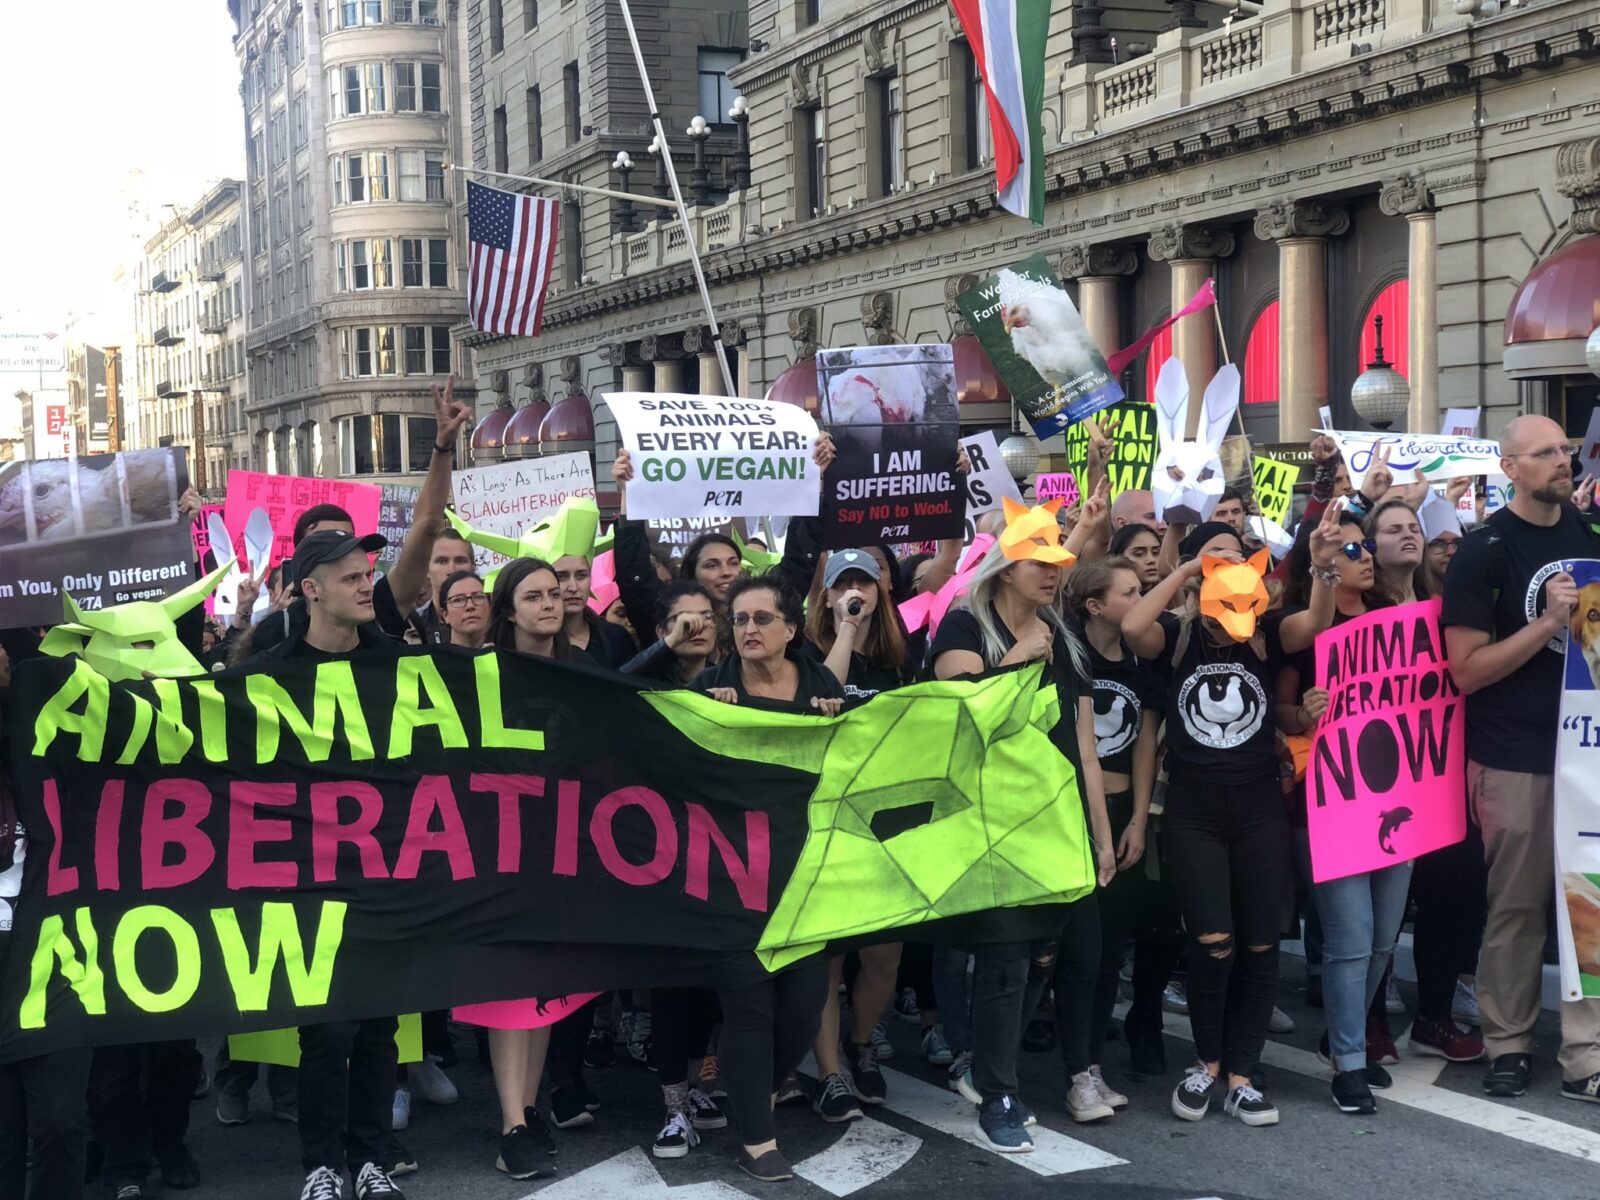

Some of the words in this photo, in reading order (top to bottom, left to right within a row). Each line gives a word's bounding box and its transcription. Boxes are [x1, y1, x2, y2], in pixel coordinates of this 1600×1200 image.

[973, 300, 1006, 323] Farm
[1045, 370, 1095, 400] Compassionate
[639, 400, 707, 411] SAVE
[715, 402, 775, 411] 100+
[1031, 400, 1055, 418] World
[659, 413, 776, 427] ANIMALS
[637, 432, 721, 451] EVERY
[730, 431, 807, 450] YEAR:
[873, 453, 880, 474] I
[887, 450, 921, 473] AM
[1342, 437, 1502, 473] Liberation
[460, 477, 477, 496] As
[515, 471, 531, 488] As
[533, 467, 566, 485] There
[569, 459, 591, 478] Are
[642, 457, 687, 482] GO
[696, 456, 806, 481] VEGAN!
[247, 475, 354, 508] FIGHT
[836, 472, 956, 501] SUFFERING.
[648, 517, 684, 529] END
[686, 515, 732, 530] WILD
[838, 508, 865, 525] Say
[869, 504, 891, 520] NO
[895, 504, 909, 518] to
[914, 500, 953, 516] Wool.
[492, 552, 515, 565] BA
[17, 579, 58, 598] You,
[63, 573, 103, 593] Only
[109, 560, 187, 587] Different
[116, 592, 130, 602] Go
[132, 589, 166, 601] vegan.
[1527, 584, 1537, 618] ANIMAL
[32, 652, 545, 764] ANIMAL
[1314, 704, 1457, 808] NOW
[43, 773, 770, 912] LIBERATION
[19, 901, 347, 1029] NOW
